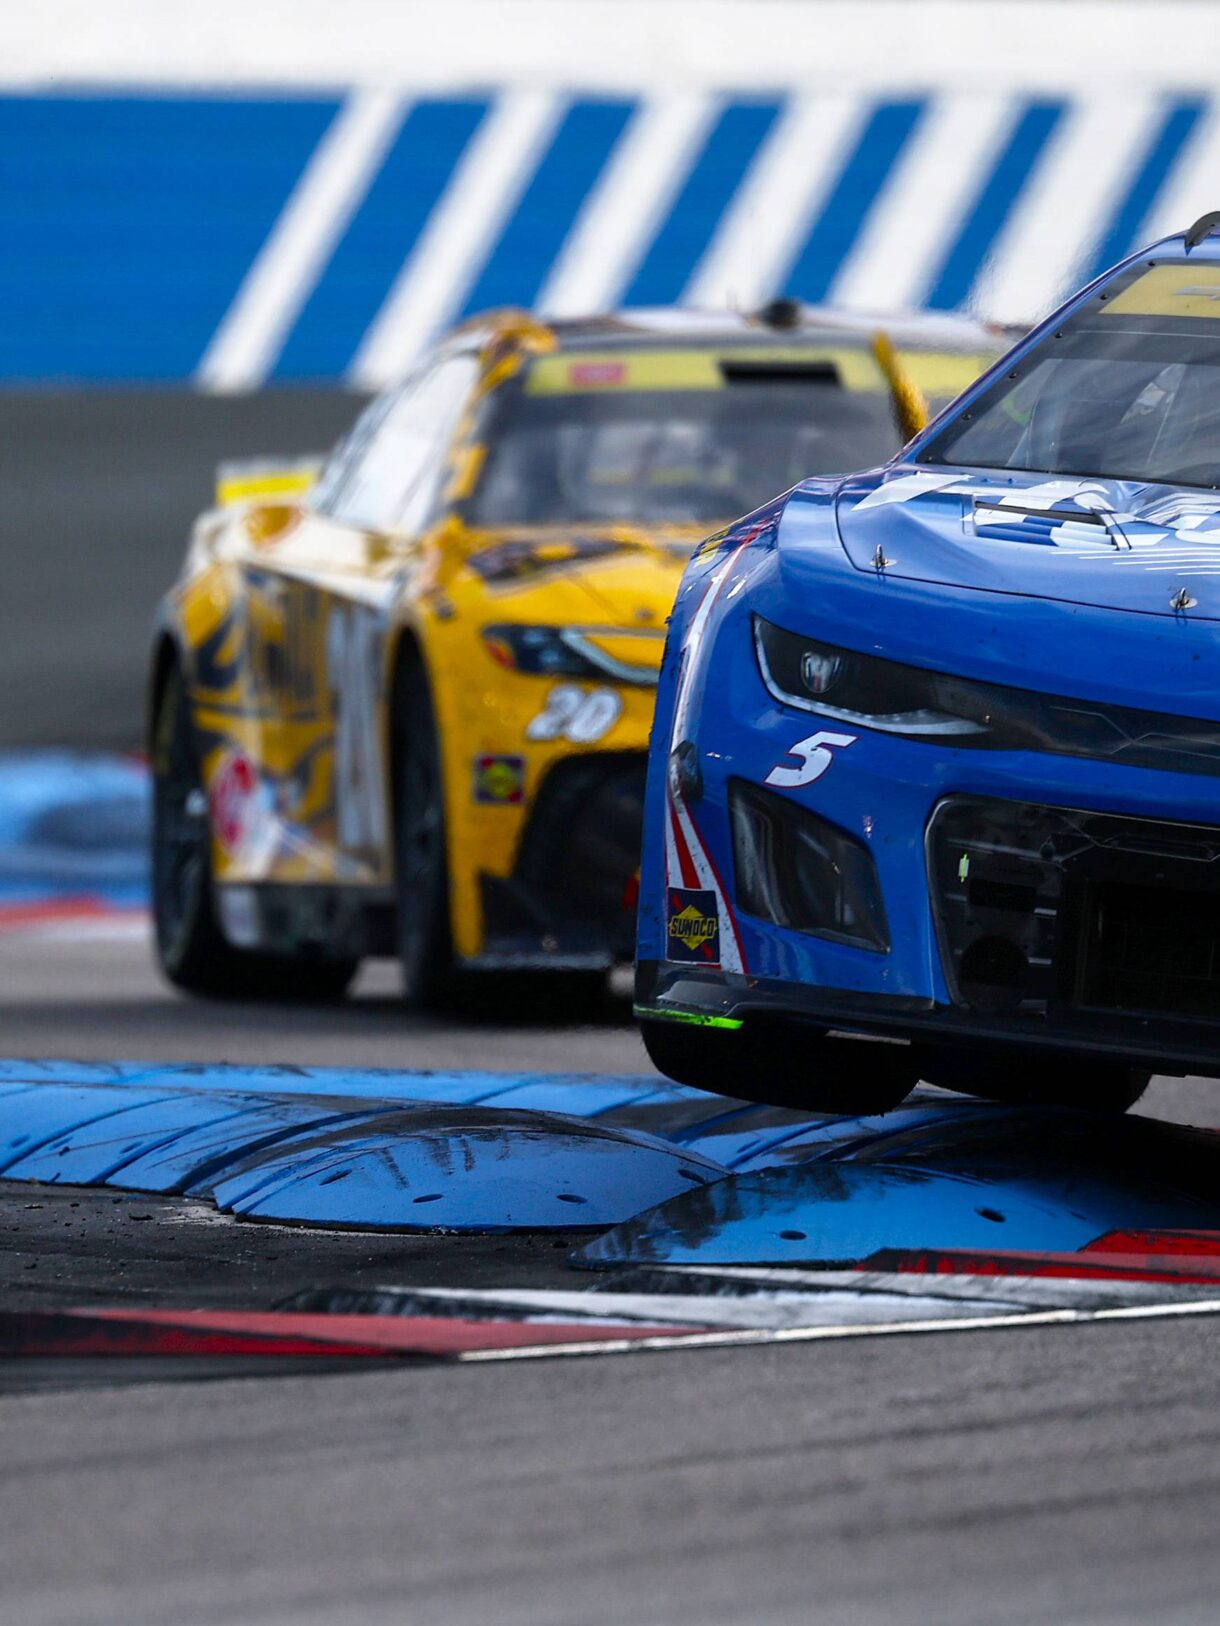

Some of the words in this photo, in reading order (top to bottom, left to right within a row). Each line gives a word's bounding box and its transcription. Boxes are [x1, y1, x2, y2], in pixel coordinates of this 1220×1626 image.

[526, 683, 623, 743] 20
[763, 730, 859, 788] 5
[670, 917, 716, 938] SUNOCO
